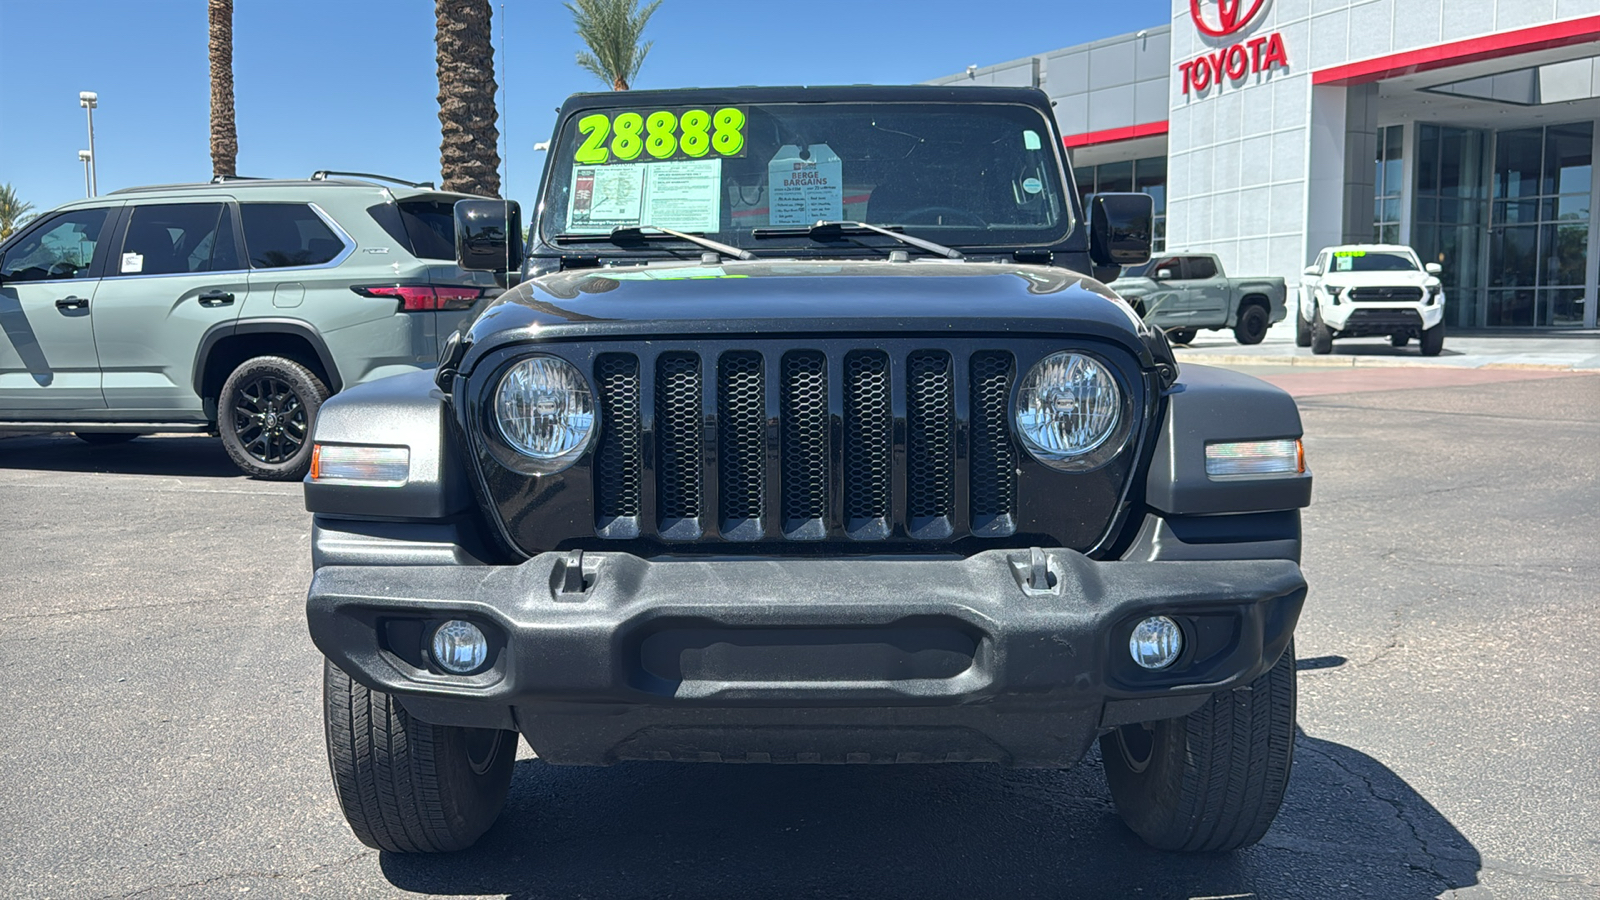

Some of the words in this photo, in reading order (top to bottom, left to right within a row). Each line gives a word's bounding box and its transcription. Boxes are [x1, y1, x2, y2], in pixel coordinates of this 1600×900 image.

[1178, 32, 1288, 95] TOYOTA
[574, 107, 746, 164] 28888
[783, 178, 828, 187] BARGAINS
[791, 171, 819, 179] BERGE
